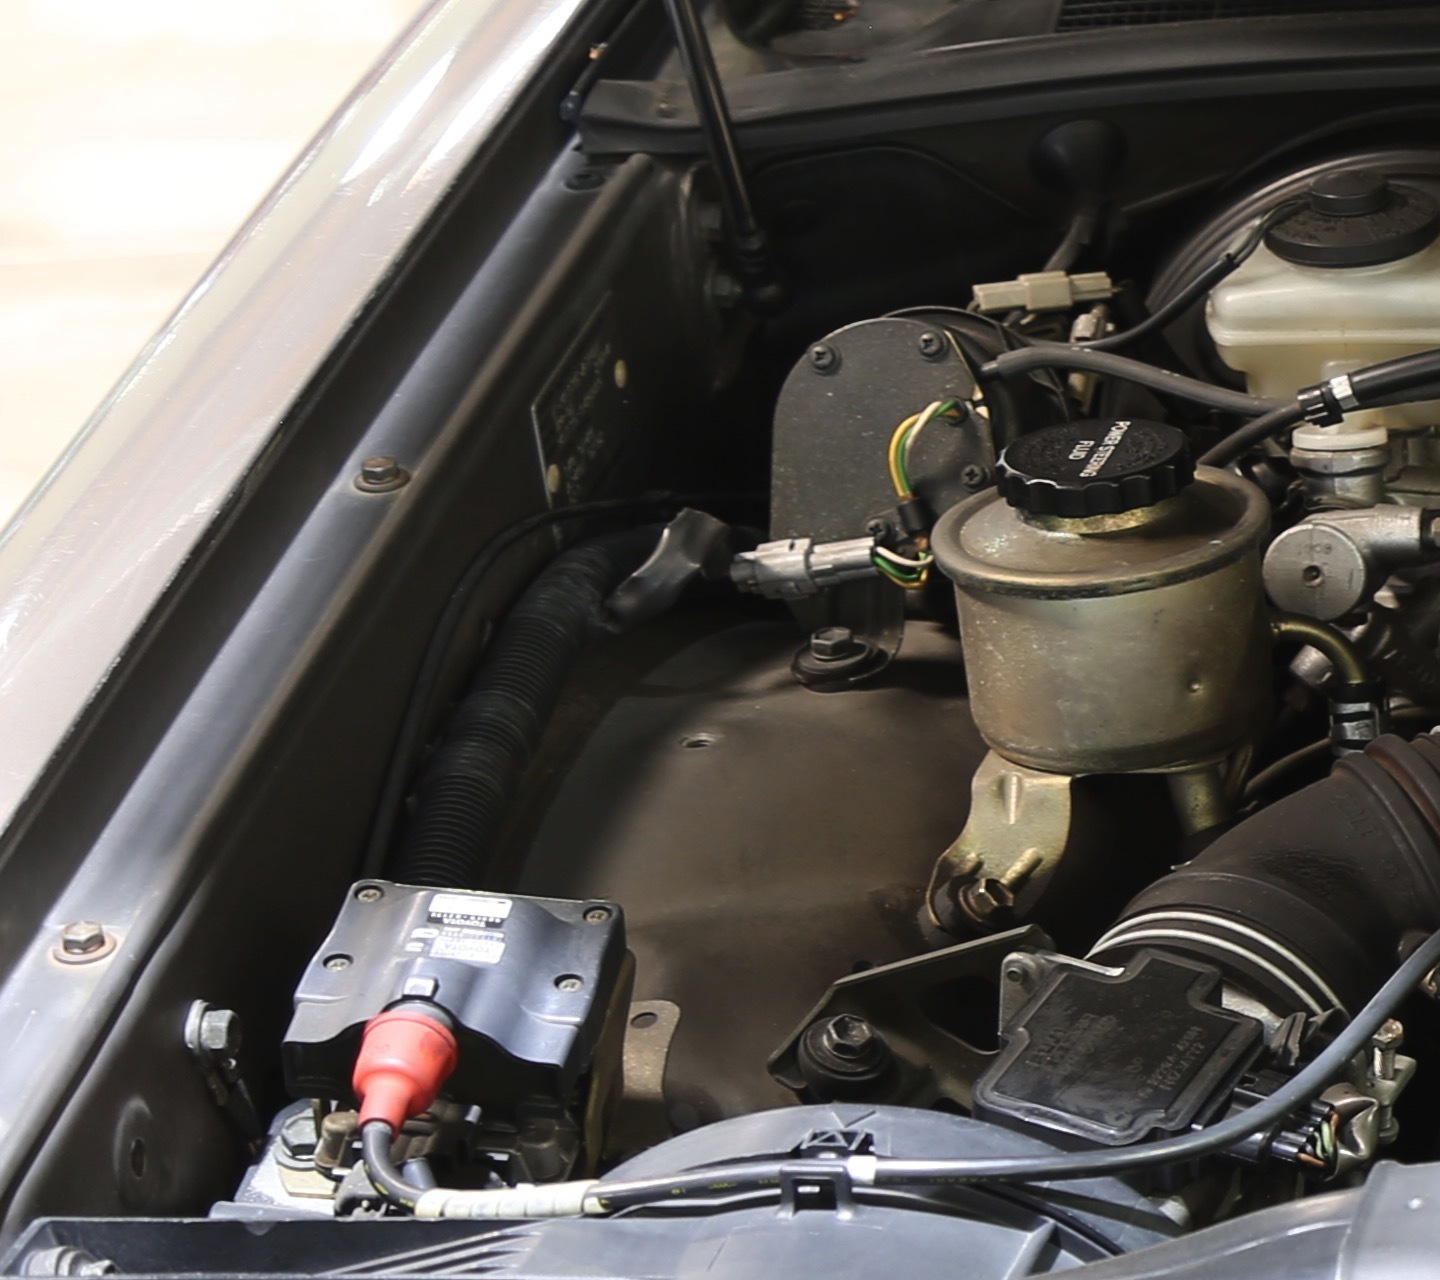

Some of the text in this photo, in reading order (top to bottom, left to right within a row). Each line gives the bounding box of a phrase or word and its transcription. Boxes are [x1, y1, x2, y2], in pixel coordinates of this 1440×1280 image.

[1068, 440, 1095, 460] FLUID
[1079, 421, 1131, 477] POWER STEERING
